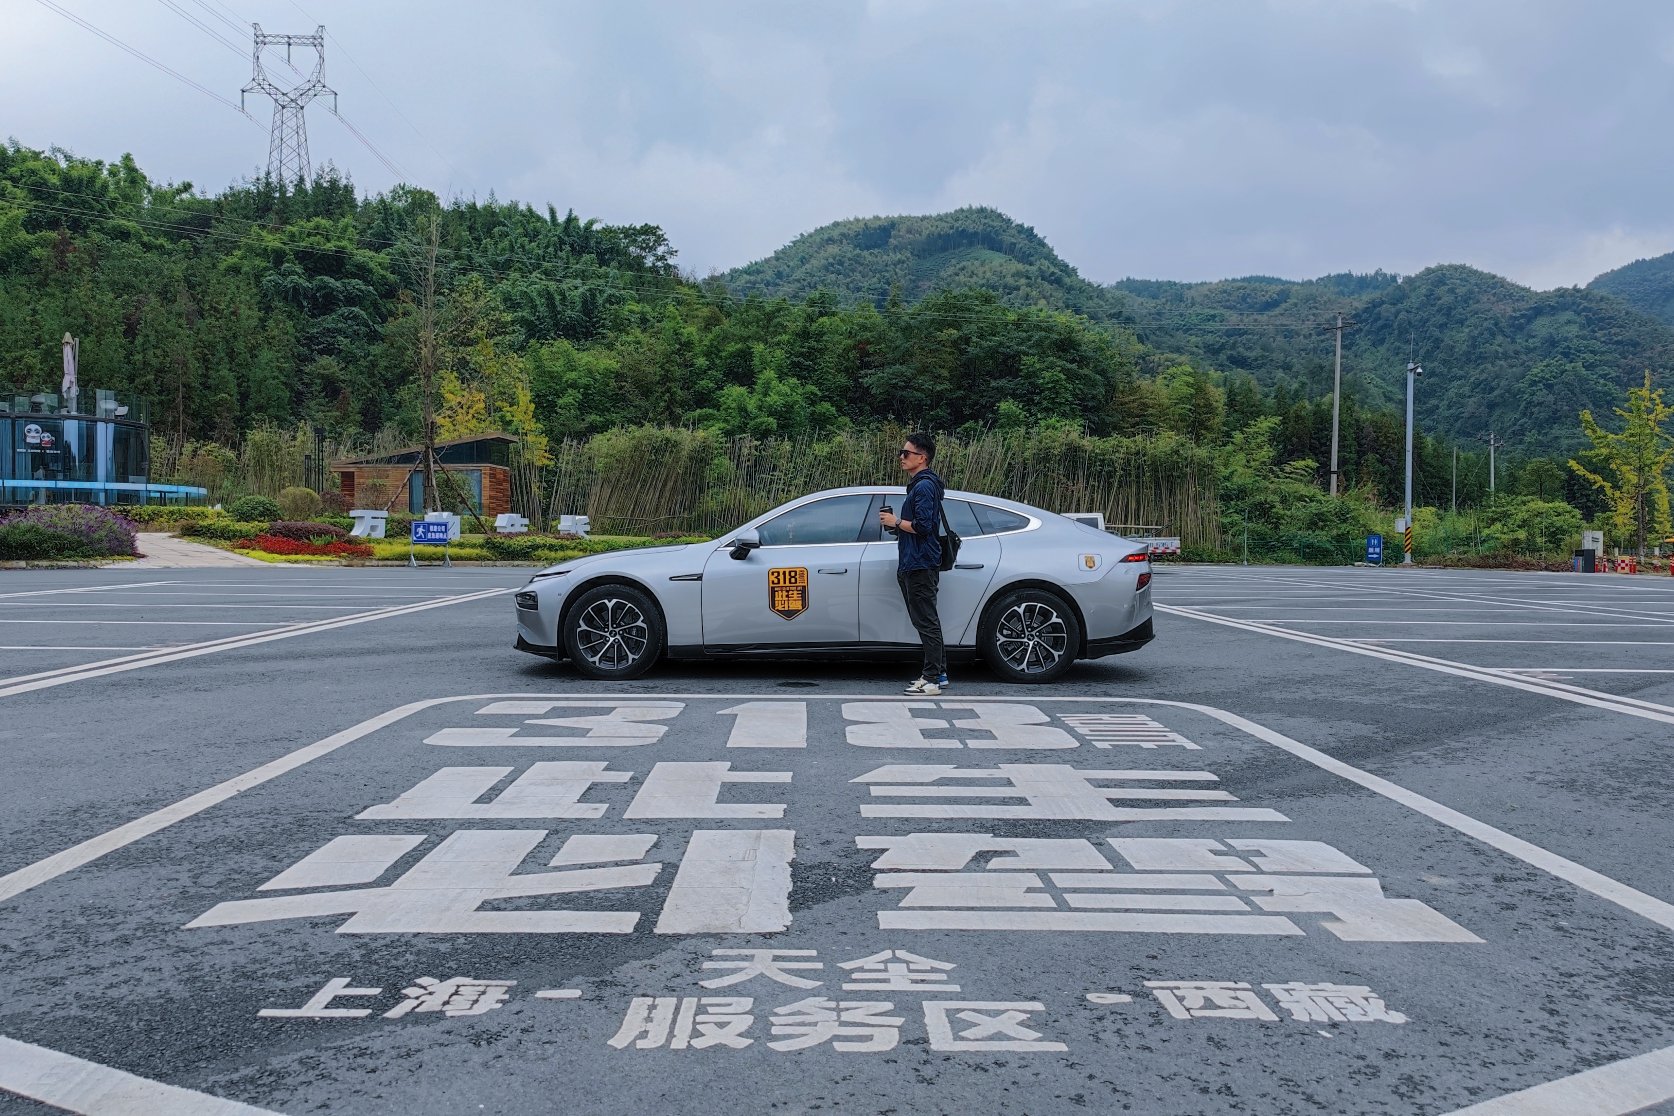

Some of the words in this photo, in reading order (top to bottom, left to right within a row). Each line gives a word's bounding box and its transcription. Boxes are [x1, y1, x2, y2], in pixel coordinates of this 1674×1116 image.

[771, 570, 798, 585] 318
[423, 701, 1080, 750] 318
[1056, 713, 1203, 750] ROUTE
[354, 761, 1292, 822] 此生
[181, 829, 1487, 944] 必驾
[697, 948, 962, 993] 天全
[606, 996, 1069, 1053] 服务区
